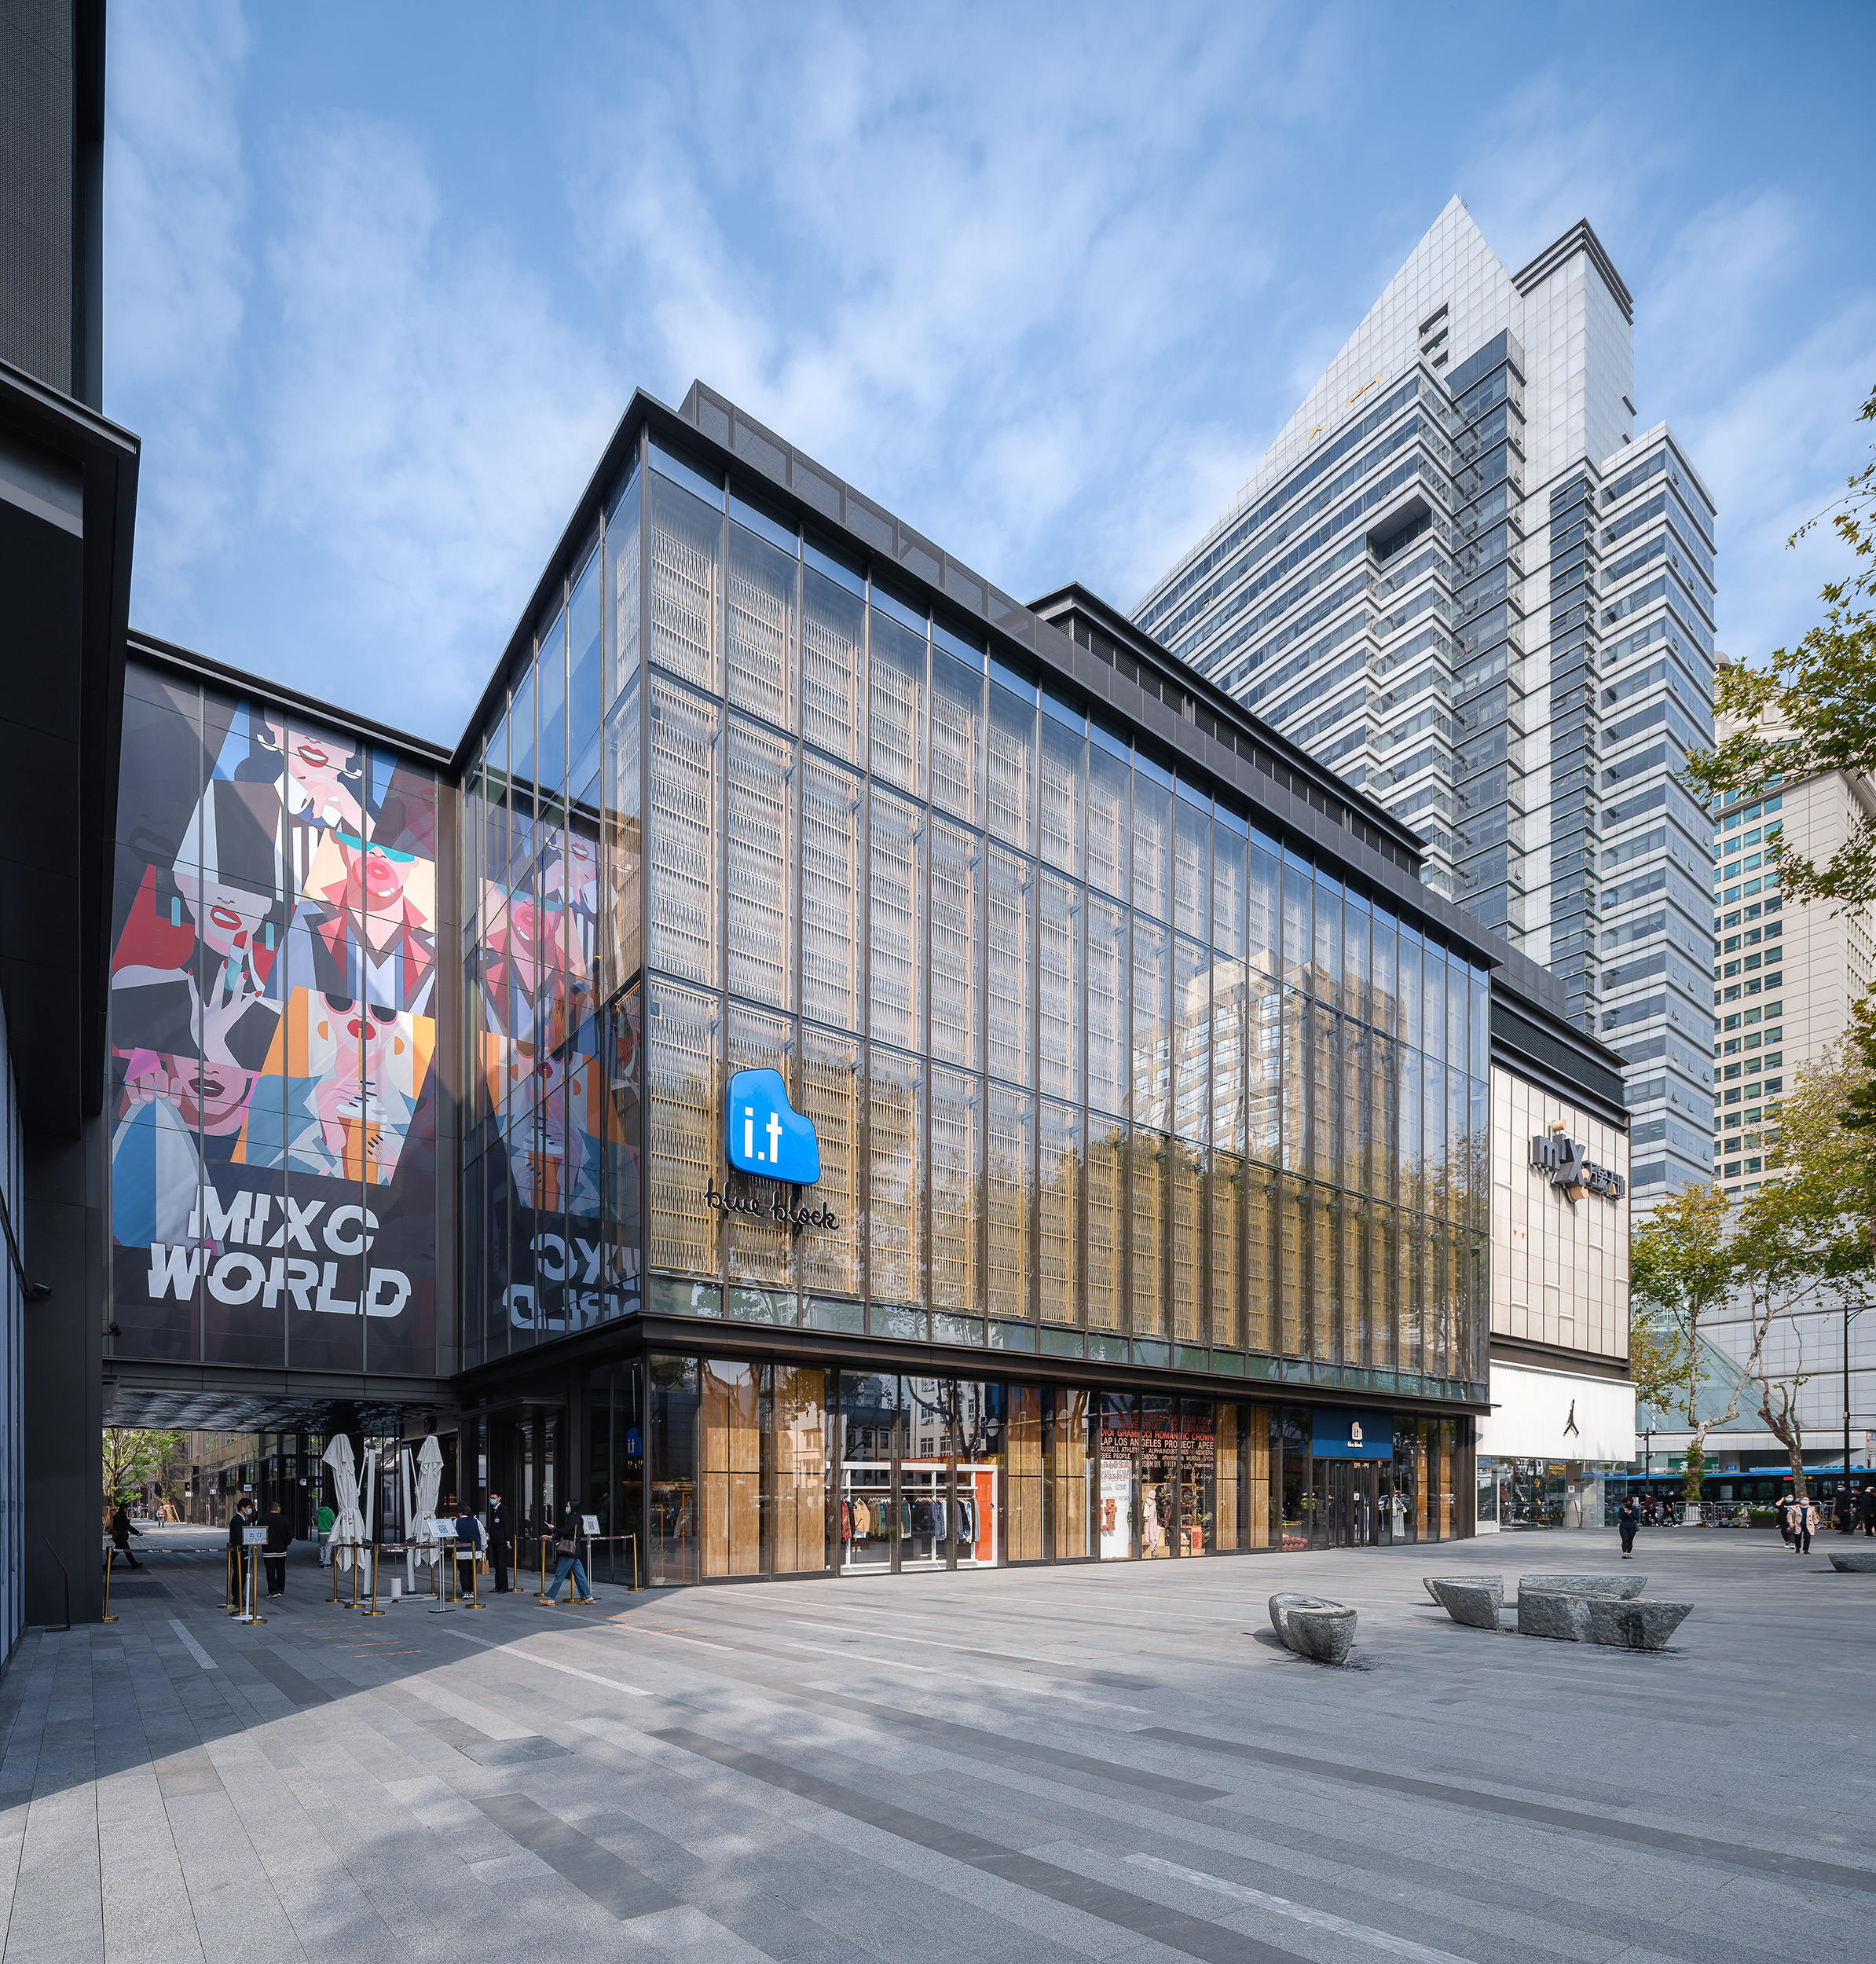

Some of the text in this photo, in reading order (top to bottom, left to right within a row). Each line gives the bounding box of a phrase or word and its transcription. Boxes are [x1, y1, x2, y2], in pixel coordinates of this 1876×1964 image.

[744, 1106, 782, 1163] i.t
[188, 1185, 379, 1255] MIXC
[703, 1178, 840, 1230] blue block
[148, 1242, 412, 1317] WORLD
[1114, 1437, 1128, 1446] LOS
[1130, 1438, 1162, 1447] ANGELES
[1164, 1439, 1196, 1449] PROJECT
[1197, 1441, 1214, 1450] APEE
[1191, 1432, 1215, 1442] CROWN
